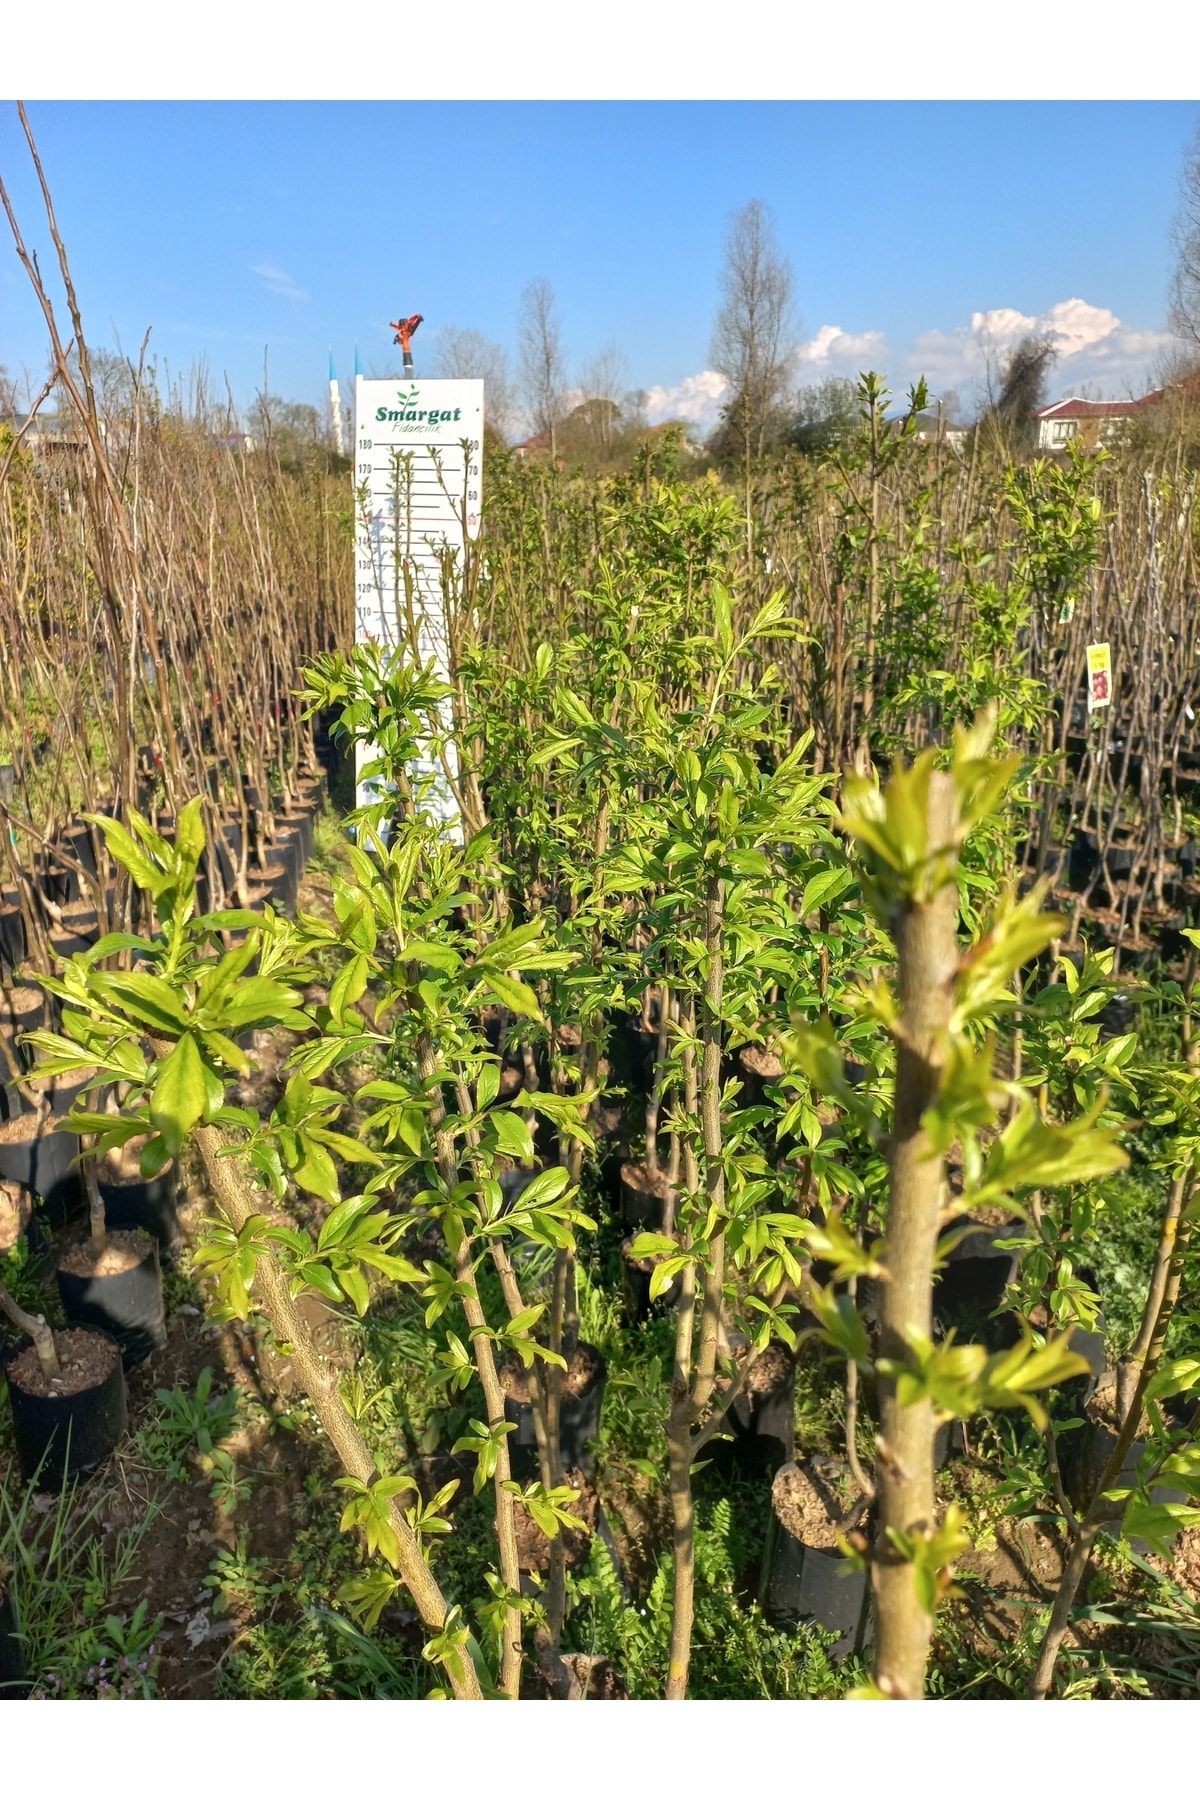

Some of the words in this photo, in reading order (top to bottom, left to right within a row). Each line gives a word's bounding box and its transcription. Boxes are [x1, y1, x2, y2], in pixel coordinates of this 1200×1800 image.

[375, 407, 461, 425] Smargat
[359, 439, 373, 450] 180
[358, 464, 372, 474] 170
[358, 560, 371, 570] 130
[358, 583, 371, 593] 120
